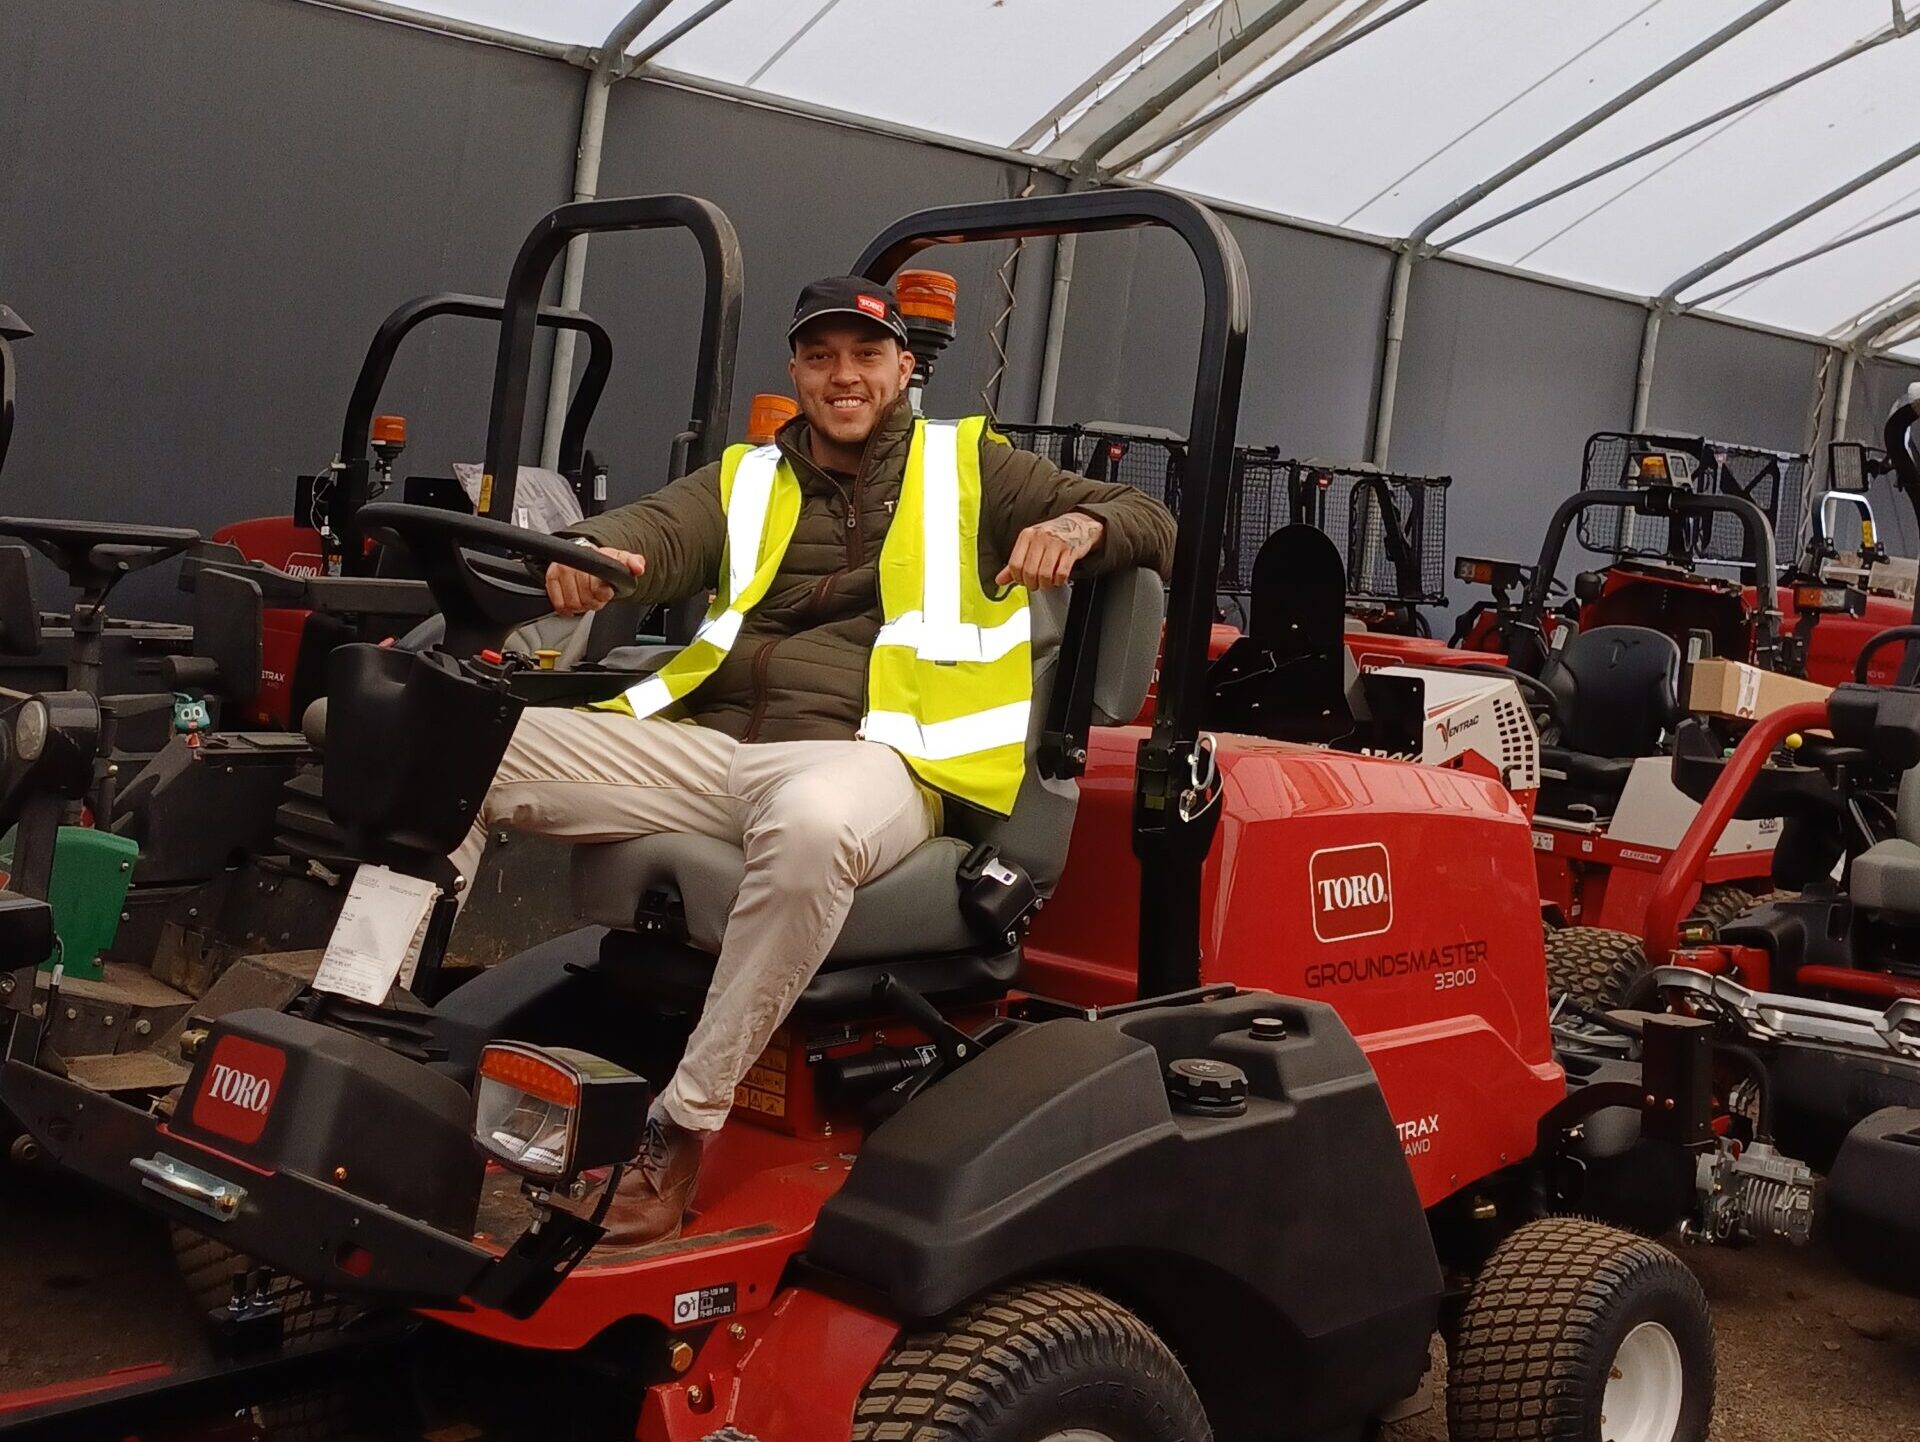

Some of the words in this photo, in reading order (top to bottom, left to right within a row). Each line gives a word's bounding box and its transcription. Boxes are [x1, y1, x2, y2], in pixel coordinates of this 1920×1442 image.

[1436, 715, 1480, 752] VENTRAC
[1318, 872, 1384, 912] TORO
[1305, 940, 1488, 988] GROUNDSMASTER
[1434, 968, 1477, 991] 3300
[208, 1064, 271, 1112] TORO
[1404, 1138, 1431, 1157] AWD
